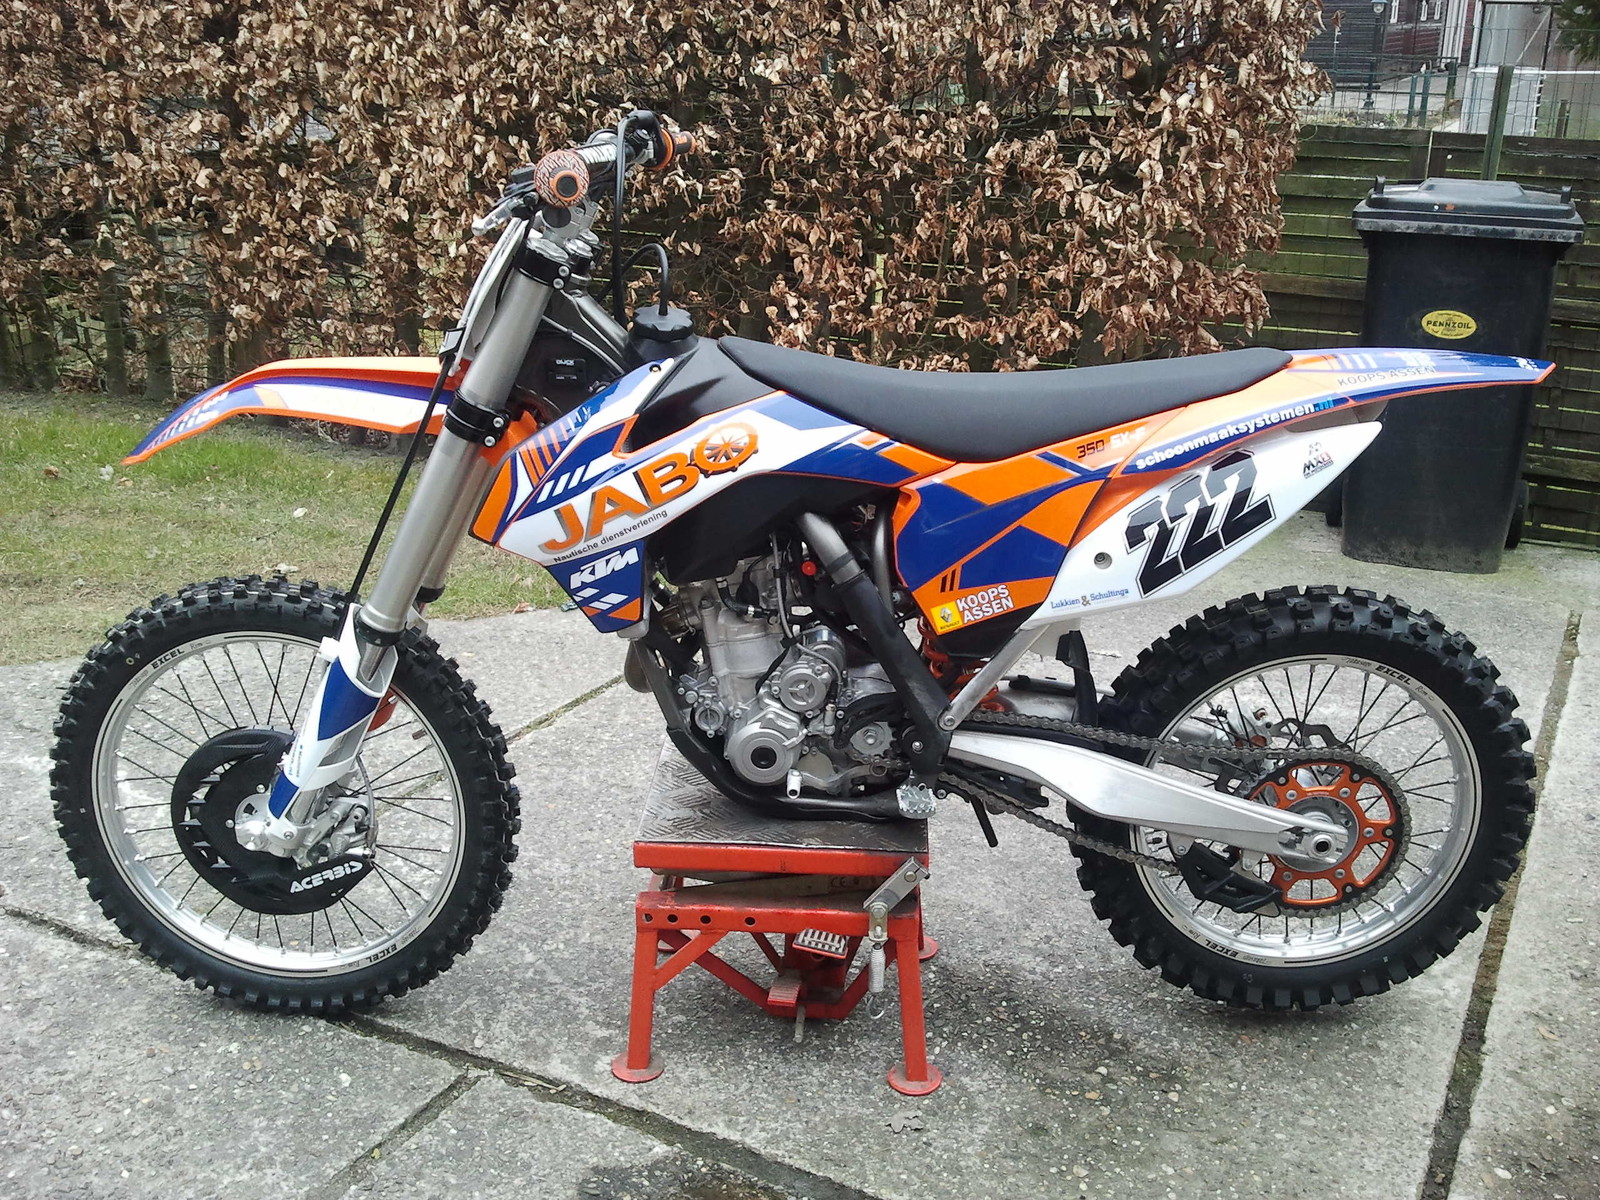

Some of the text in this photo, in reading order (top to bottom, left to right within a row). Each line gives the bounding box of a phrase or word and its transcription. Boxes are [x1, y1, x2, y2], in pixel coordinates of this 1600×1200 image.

[1426, 319, 1472, 329] PENNZOIL
[1337, 364, 1436, 386] KOOPS ASSEN
[1135, 398, 1335, 470] schoonmaaksystemen.nl
[1076, 439, 1105, 459] 350
[1122, 448, 1277, 599] 222
[553, 509, 668, 563] Nautische dienstverlening
[569, 547, 640, 590] KTM
[956, 584, 1010, 612] KOOPS
[1050, 588, 1129, 609] Lukkien & Schultinga
[963, 596, 1015, 624] ASSEN
[151, 648, 185, 670] EXCEL
[1375, 664, 1411, 686] EXCEL
[366, 943, 398, 963] EXCEL
[1205, 938, 1239, 958] EXCEL
